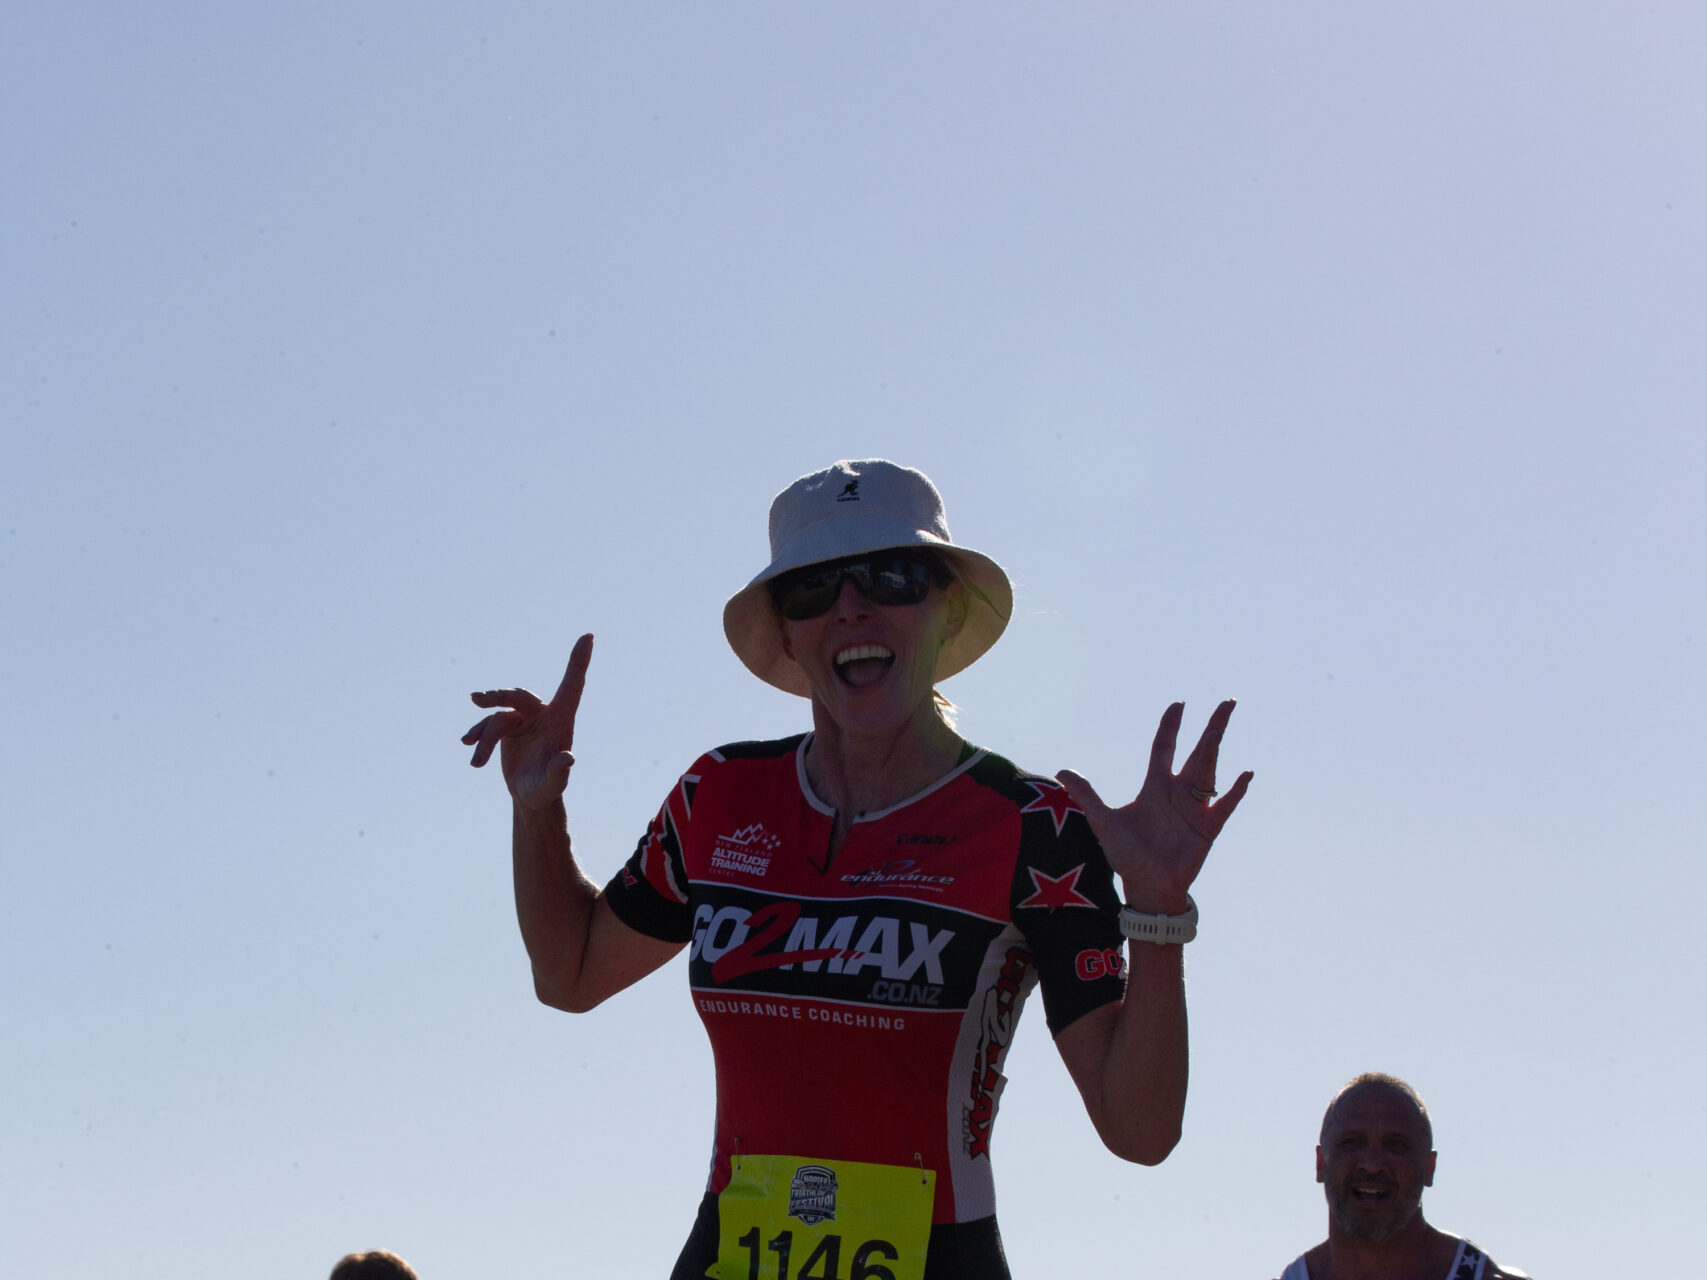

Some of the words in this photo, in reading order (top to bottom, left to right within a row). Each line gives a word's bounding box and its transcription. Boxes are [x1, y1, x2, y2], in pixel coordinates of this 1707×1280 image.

[710, 857, 767, 877] TRAINING
[711, 847, 771, 867] ALTITUDE
[840, 873, 955, 886] endurance
[690, 901, 956, 985] GO2MAX
[866, 980, 944, 1005] .CO.NZ
[699, 999, 803, 1020] ENDURANCE
[808, 1007, 906, 1031] COACHING
